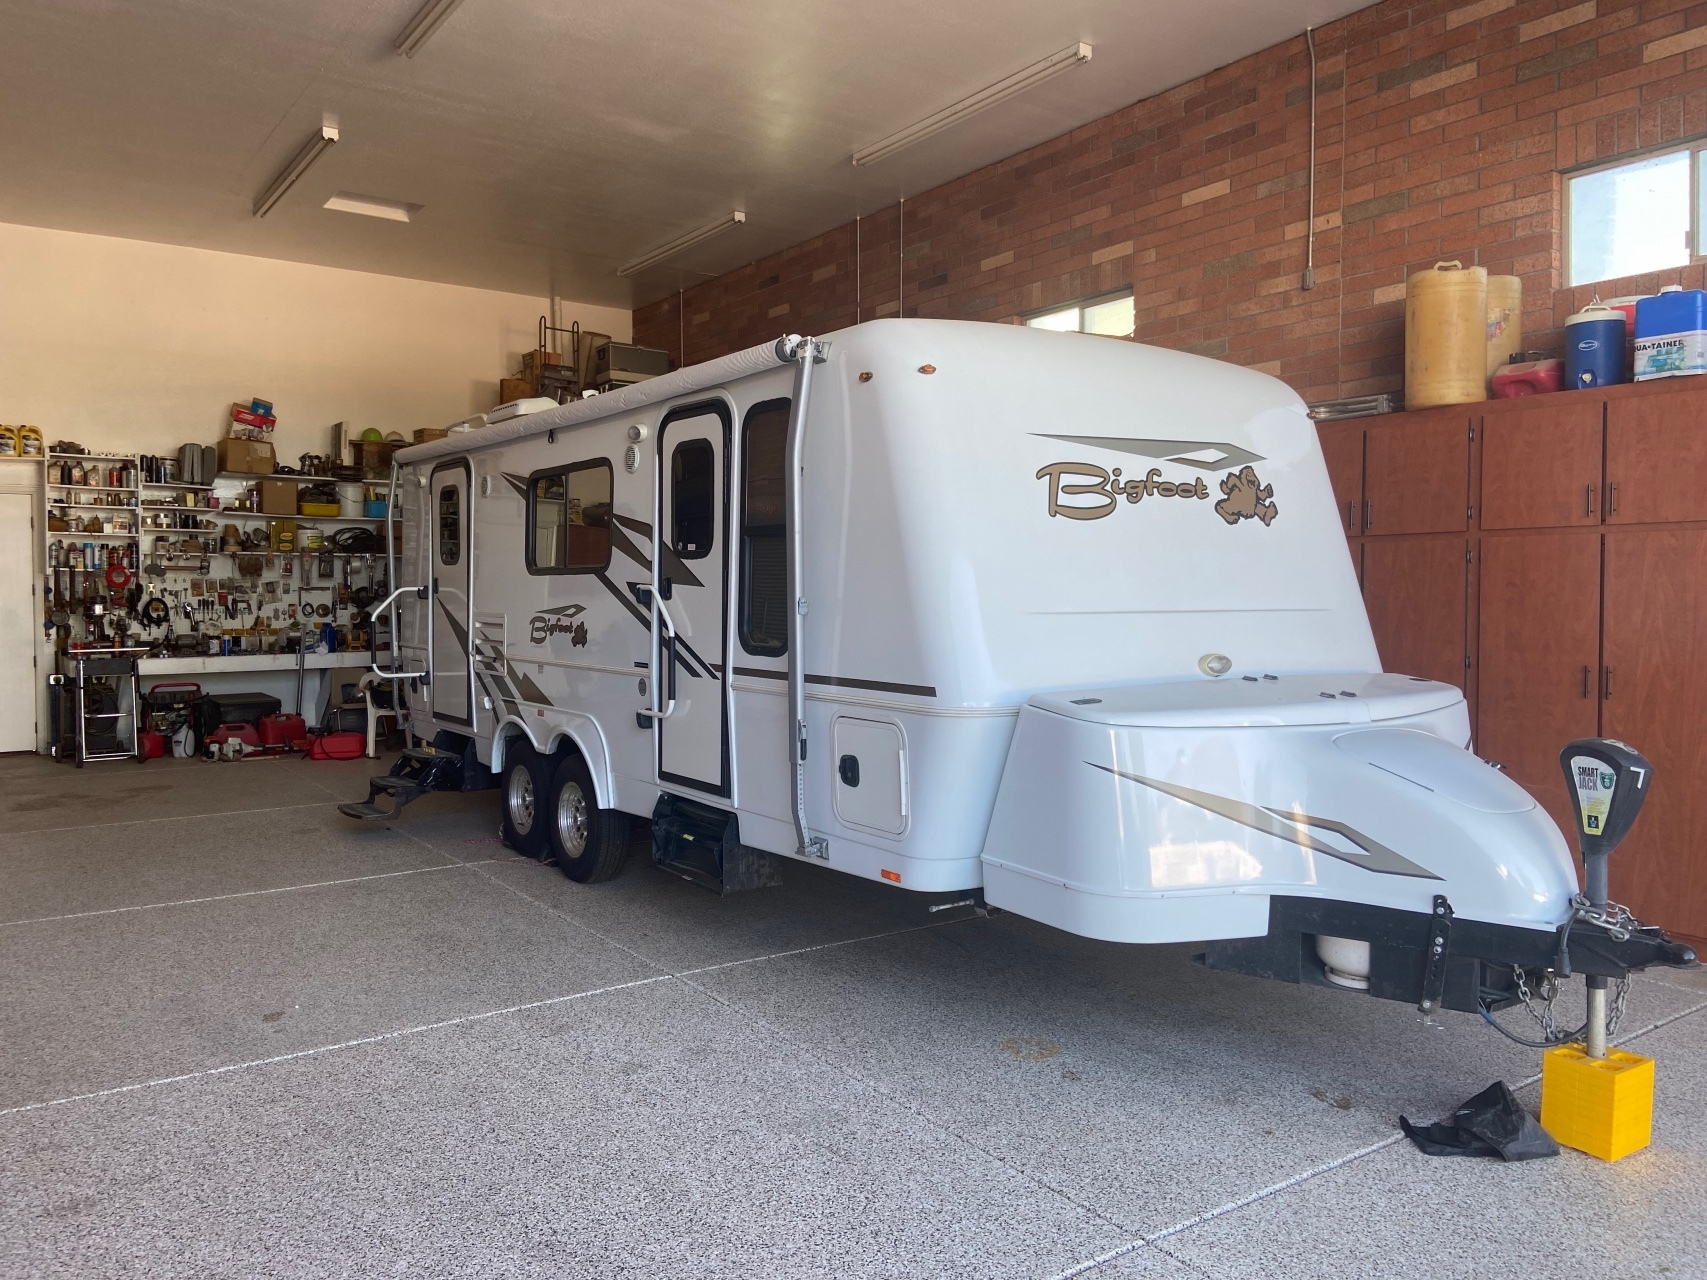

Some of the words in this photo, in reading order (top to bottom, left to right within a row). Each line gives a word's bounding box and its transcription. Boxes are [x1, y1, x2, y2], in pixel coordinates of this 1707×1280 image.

[1035, 461, 1210, 521] Bigfoot
[529, 615, 574, 645] Bigfoot
[1577, 766, 1599, 778] SMART
[1578, 776, 1599, 792] JACK
